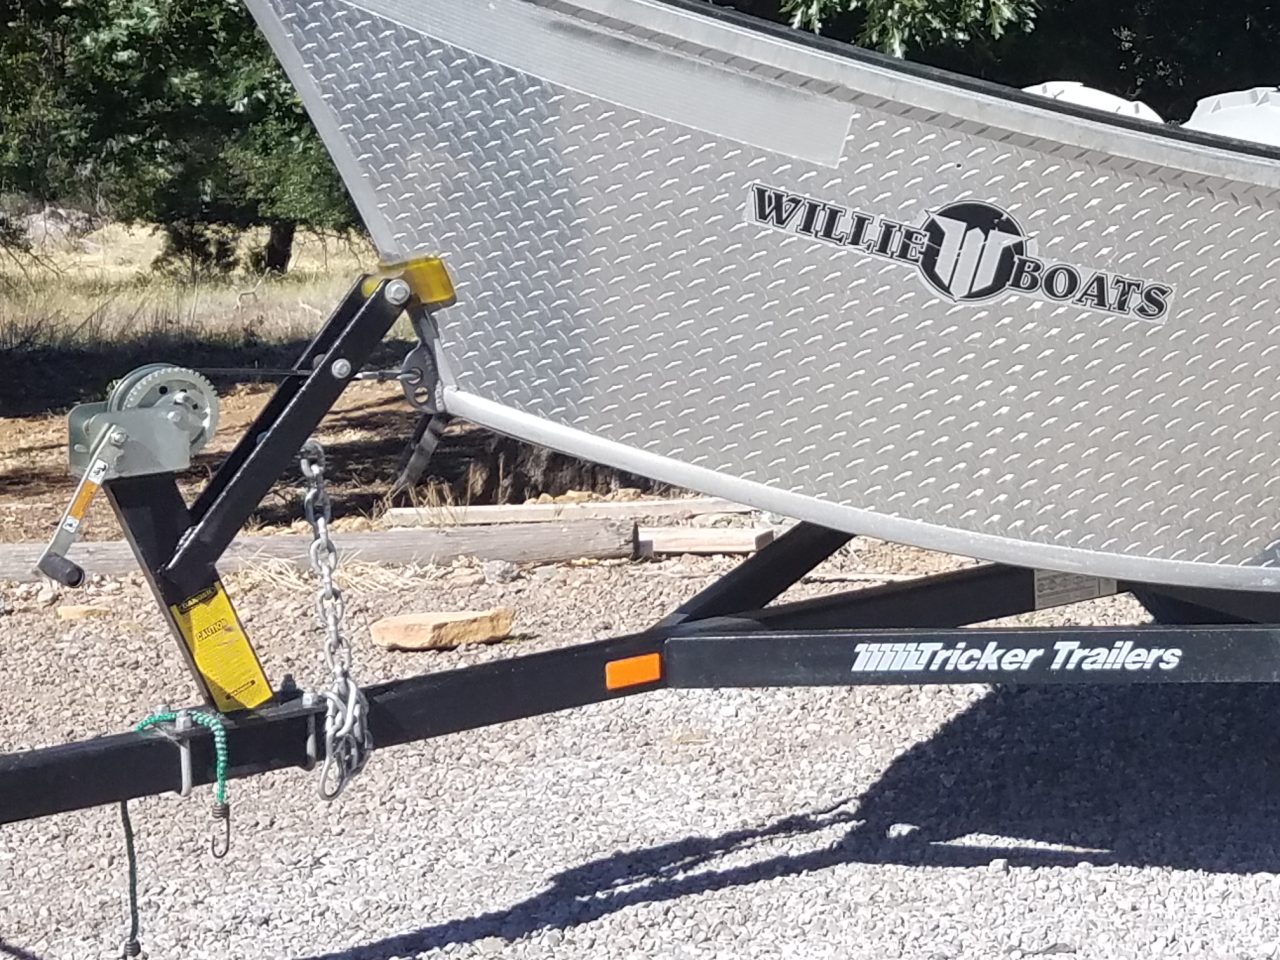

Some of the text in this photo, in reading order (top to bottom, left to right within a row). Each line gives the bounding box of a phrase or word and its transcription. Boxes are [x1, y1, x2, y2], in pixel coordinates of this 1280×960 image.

[752, 183, 928, 264] WILLIE
[1007, 256, 1174, 321] BOATS
[914, 640, 1183, 671] Tricker Trailers
